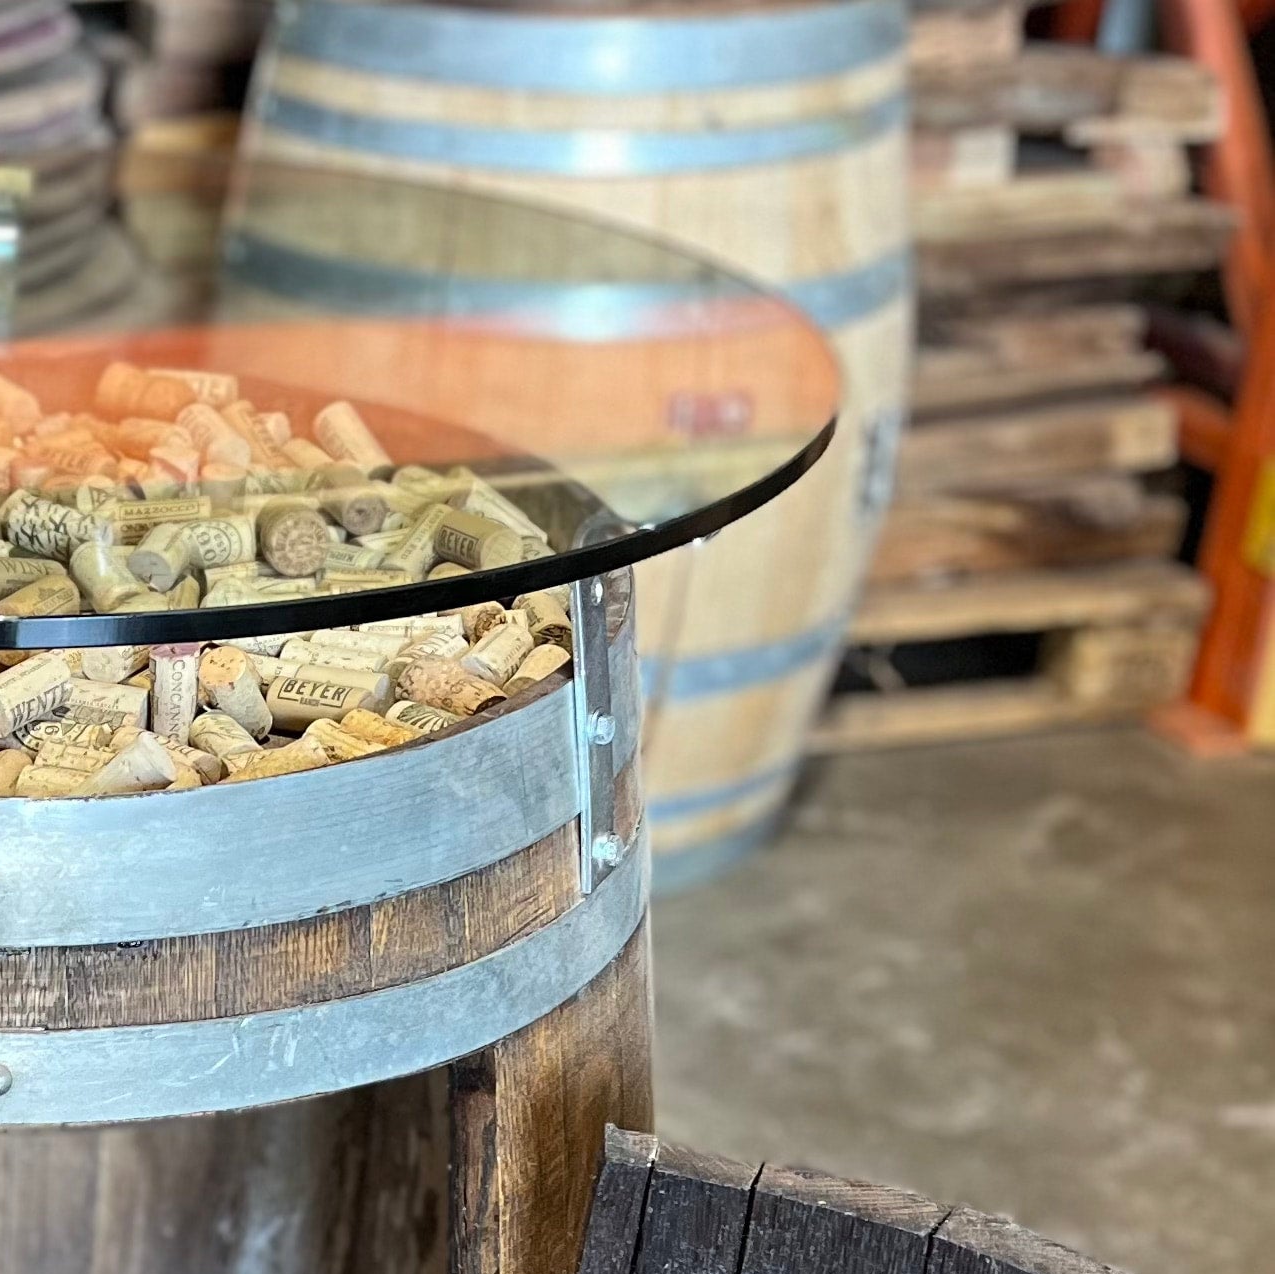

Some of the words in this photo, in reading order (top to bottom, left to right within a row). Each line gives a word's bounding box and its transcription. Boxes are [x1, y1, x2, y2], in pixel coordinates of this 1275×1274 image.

[10, 680, 74, 730] WENTE
[168, 659, 186, 744] CONCANNO
[283, 680, 346, 702] BEYER
